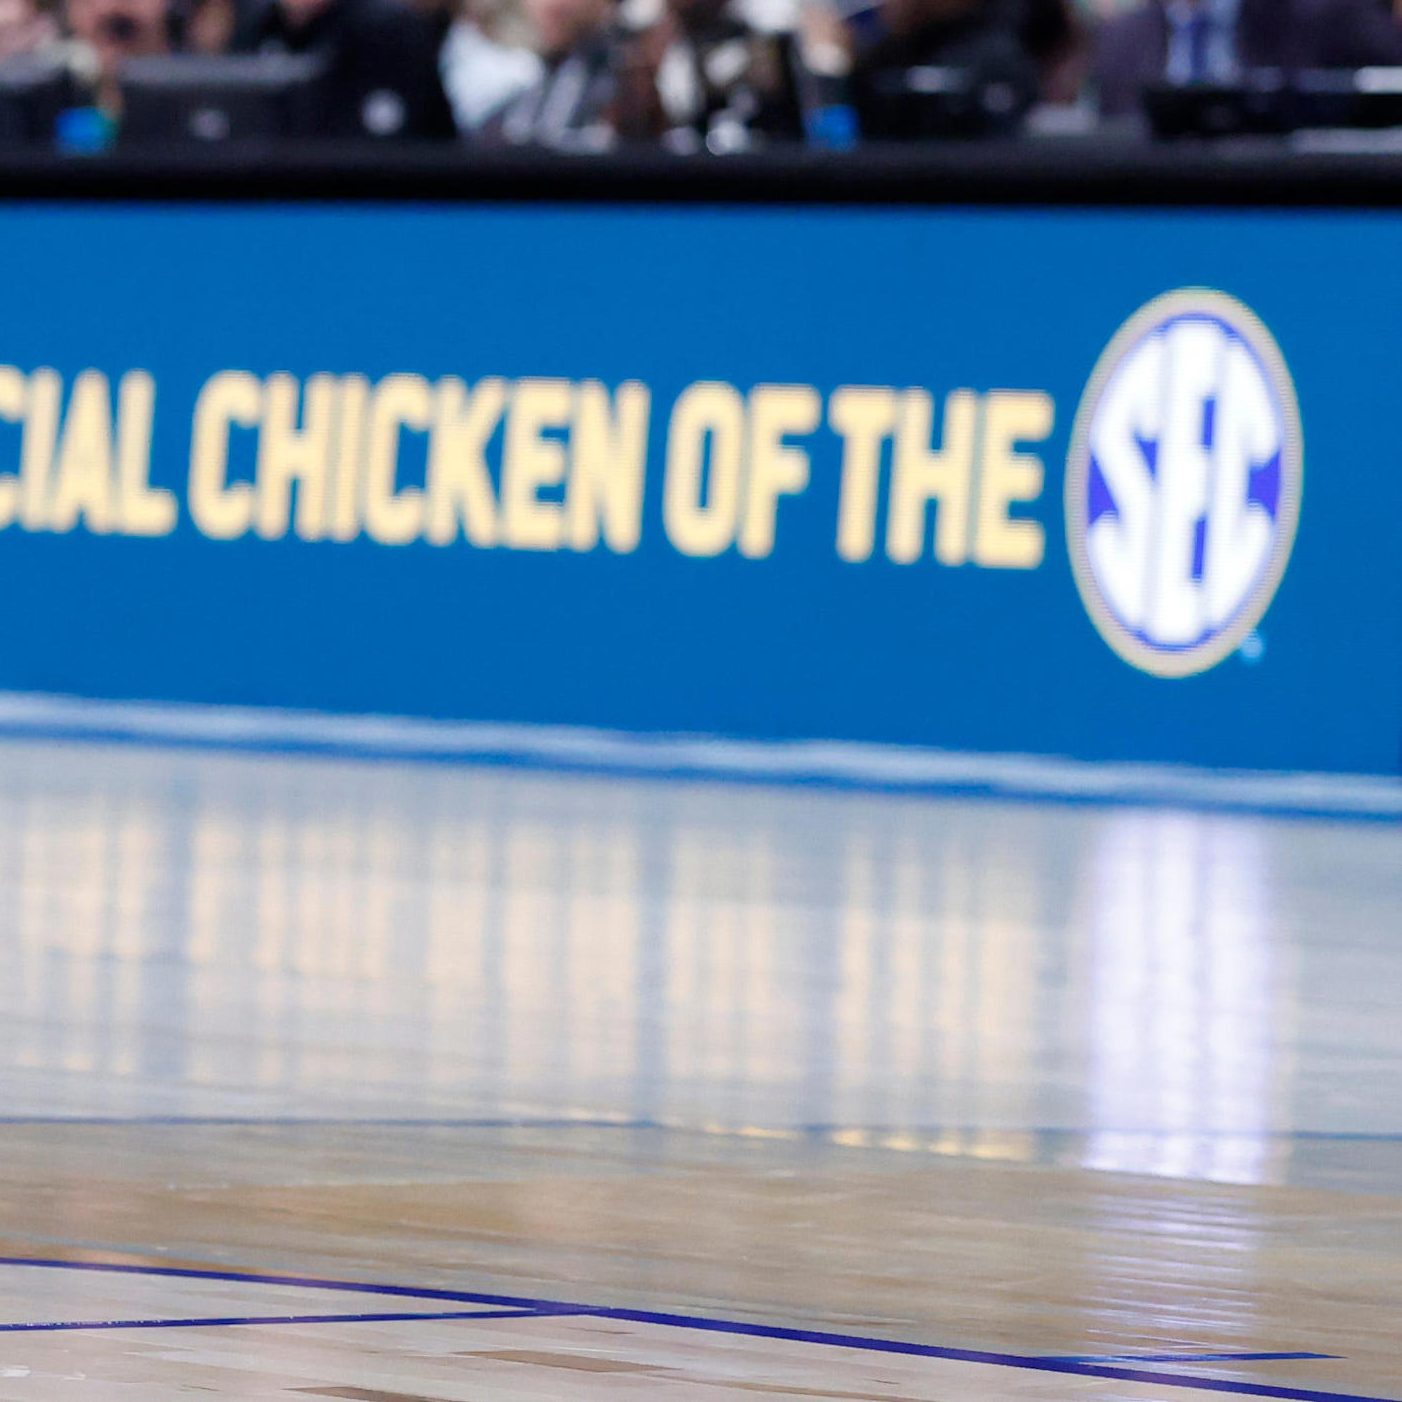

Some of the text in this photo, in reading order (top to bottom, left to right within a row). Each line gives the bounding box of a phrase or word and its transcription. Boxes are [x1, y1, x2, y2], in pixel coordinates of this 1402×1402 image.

[188, 370, 652, 554] CHICKEN
[662, 380, 820, 558] OF
[828, 386, 1054, 568] THE
[1084, 320, 1282, 646] SEC
